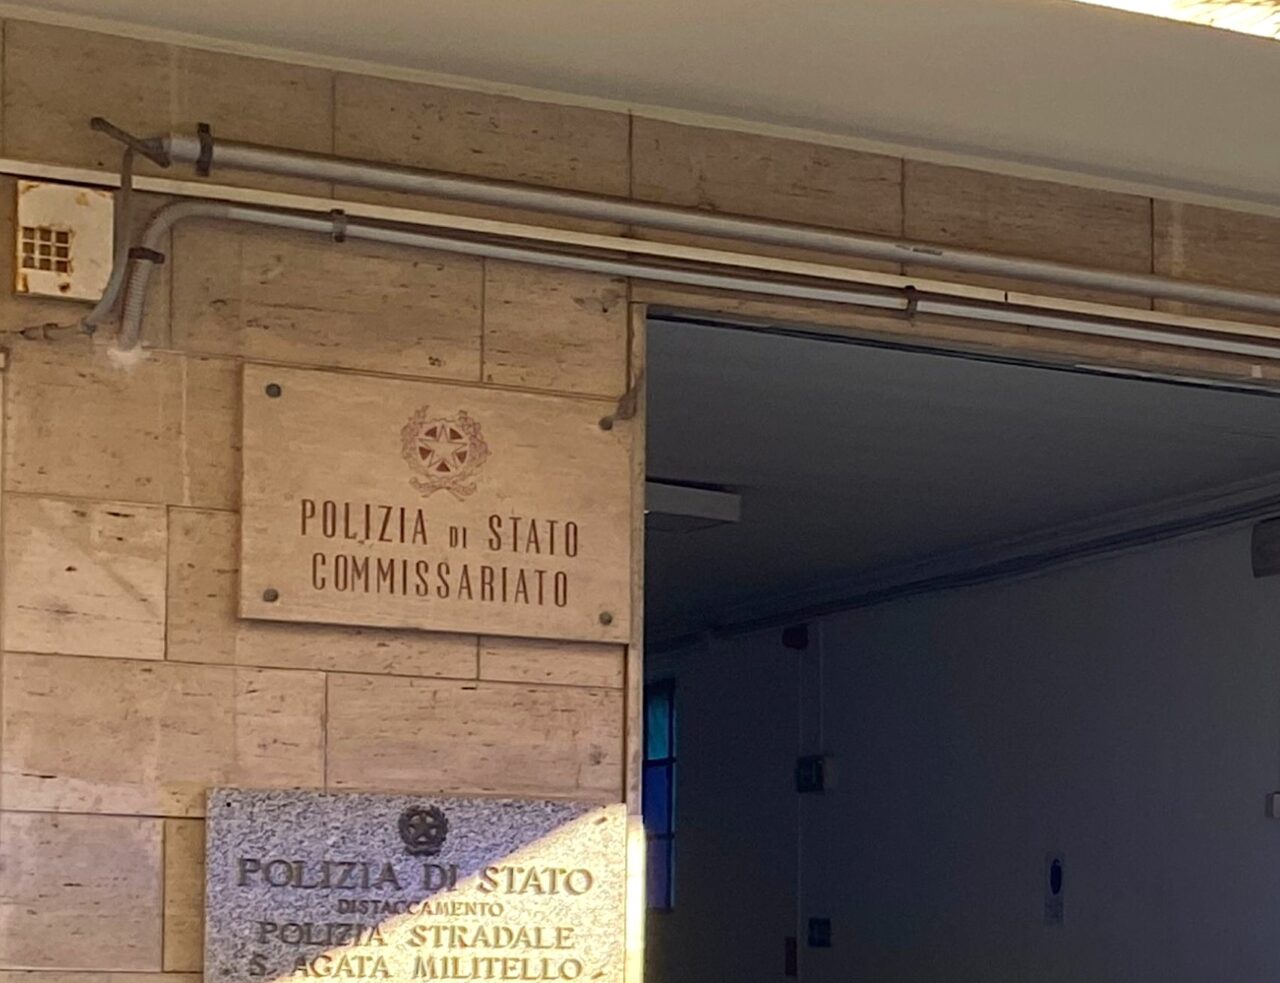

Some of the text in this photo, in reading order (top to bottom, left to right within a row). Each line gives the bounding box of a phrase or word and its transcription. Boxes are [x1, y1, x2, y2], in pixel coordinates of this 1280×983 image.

[300, 498, 579, 559] POLIZIA DI STATO
[311, 551, 569, 608] COMMISSARIATO
[236, 857, 594, 896] POLIZIA DI STATO
[336, 898, 505, 917] DISTACCAMENTO
[256, 920, 576, 950] POLIZIA STRADALE
[289, 953, 394, 979] AGATA
[411, 955, 584, 981] MILITELLO
